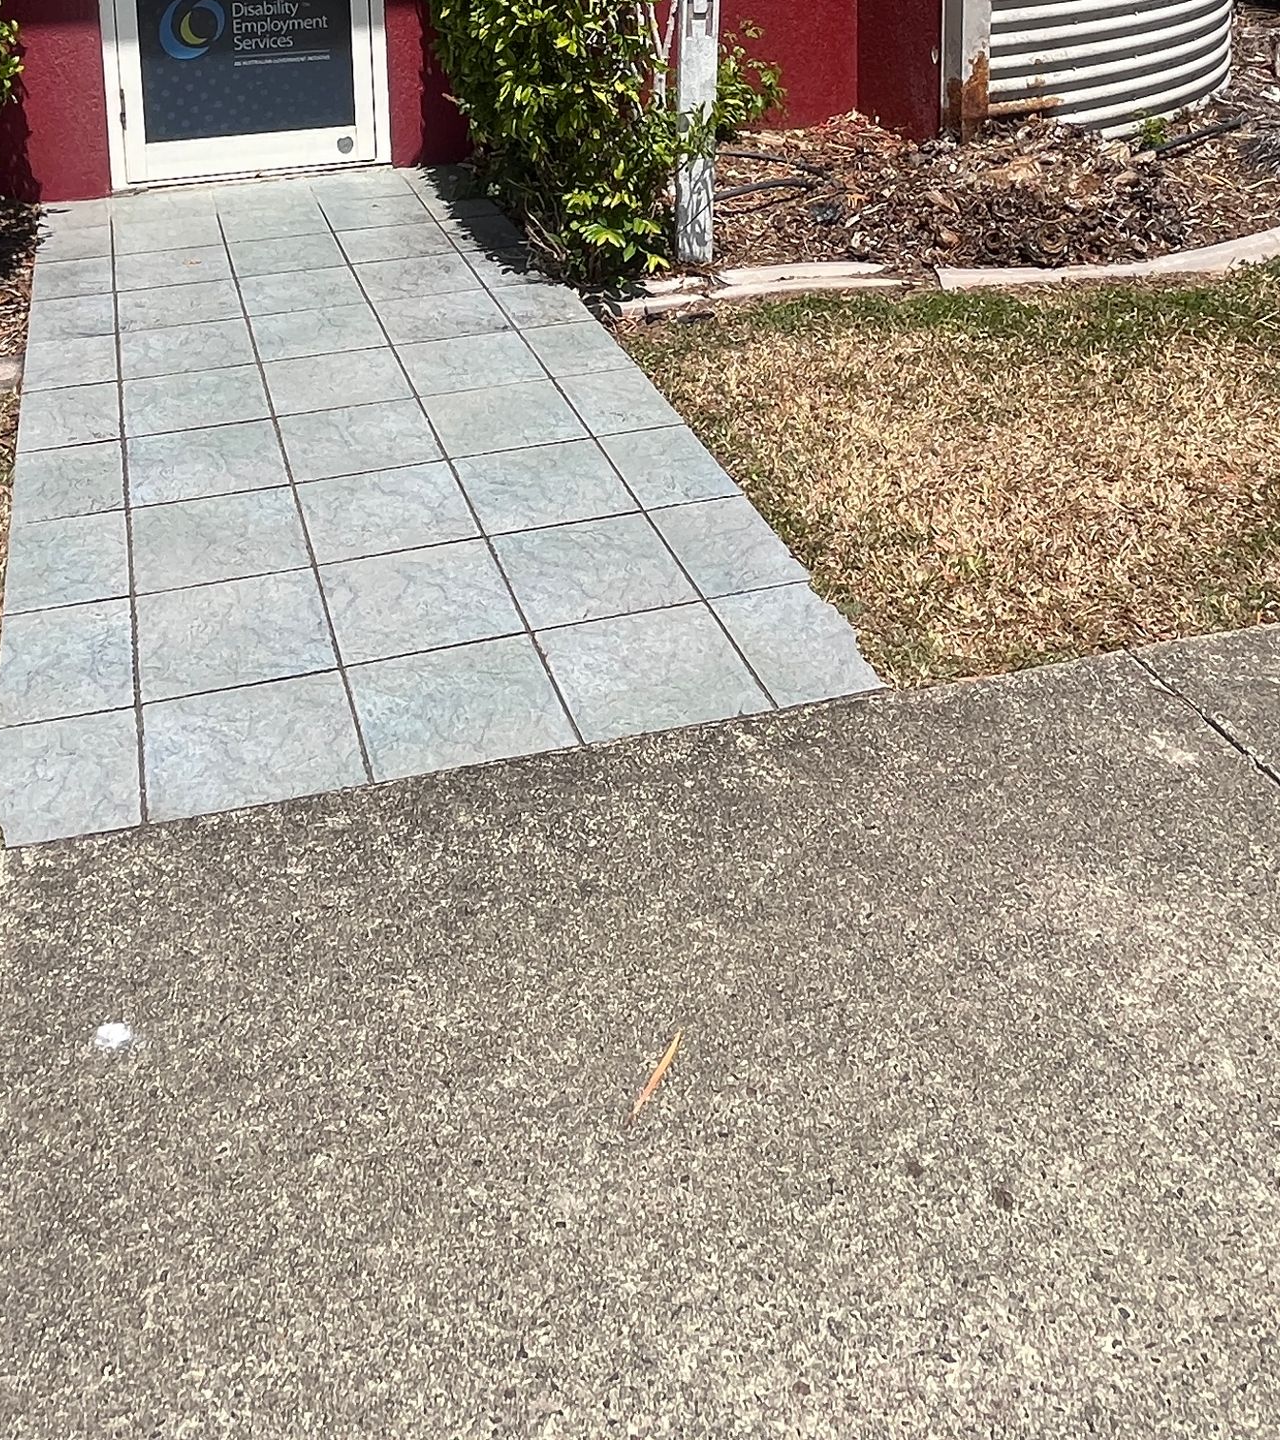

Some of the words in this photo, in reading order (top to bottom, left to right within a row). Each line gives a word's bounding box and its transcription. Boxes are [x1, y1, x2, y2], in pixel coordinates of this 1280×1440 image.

[231, 0, 299, 17] Disability
[232, 16, 328, 36] Employment
[233, 34, 294, 51] Services
